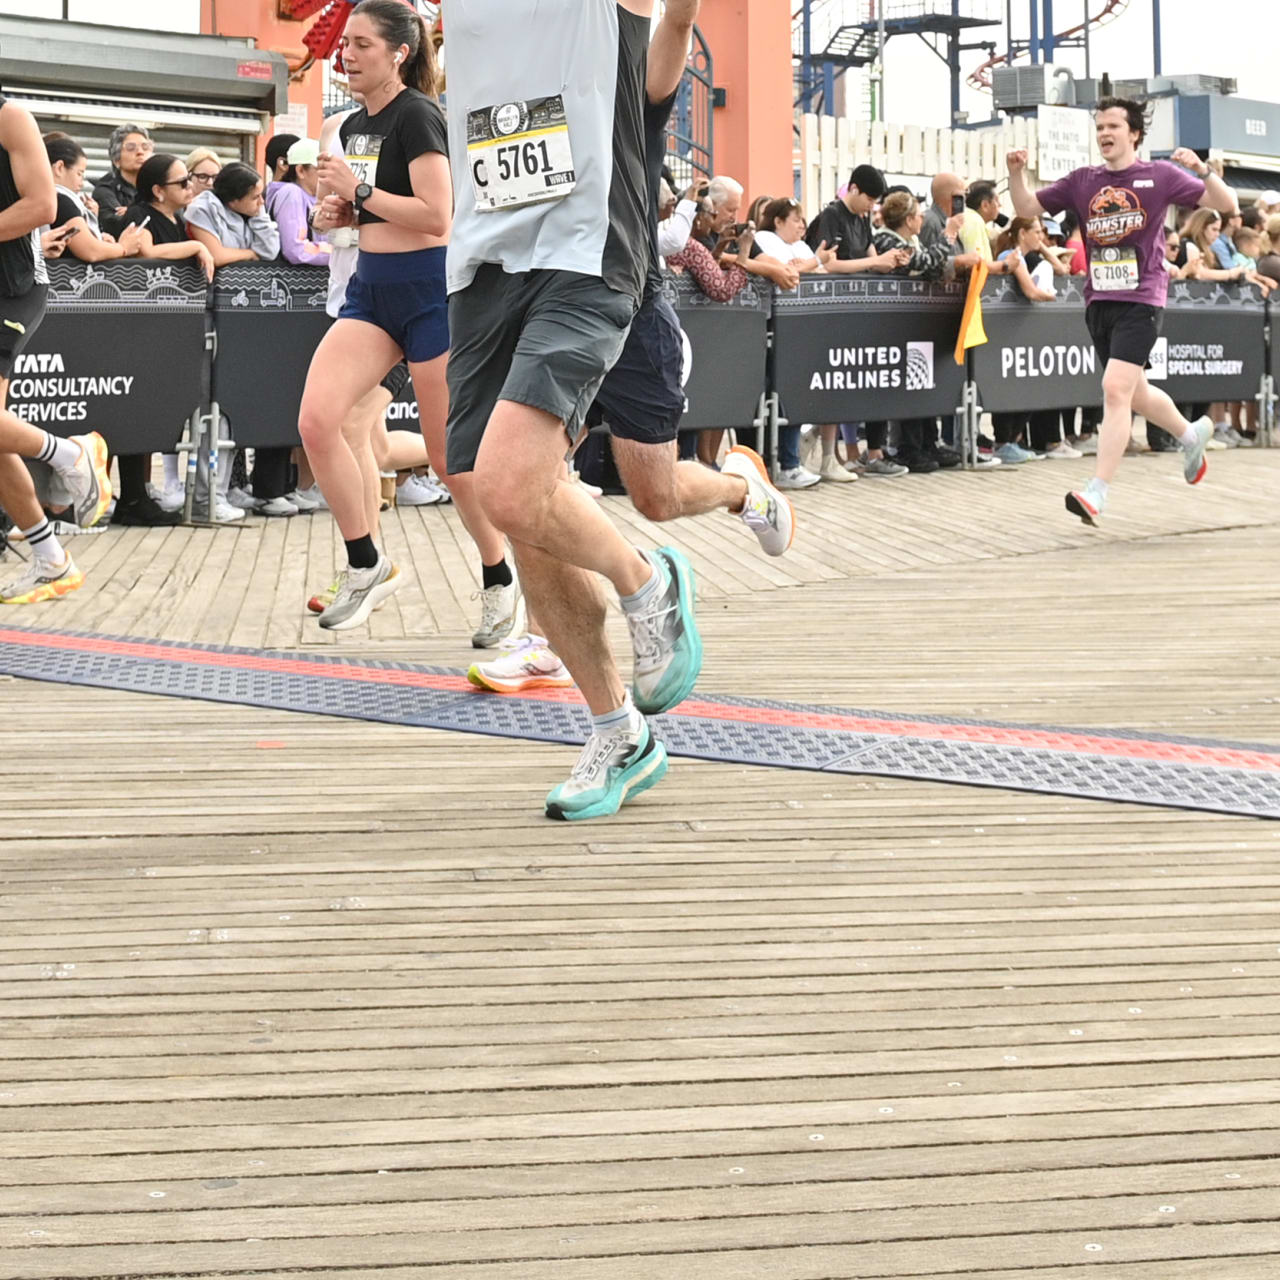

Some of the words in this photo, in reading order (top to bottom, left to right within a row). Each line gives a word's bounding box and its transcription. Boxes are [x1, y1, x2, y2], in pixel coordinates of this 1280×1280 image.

[474, 159, 488, 187] C
[497, 140, 553, 180] 5761
[1093, 268, 1100, 280] C
[1104, 265, 1129, 280] 7108
[829, 346, 901, 367] UNITED
[1001, 345, 1095, 378] PELOTON
[1168, 344, 1205, 358] HOSPITAL
[1208, 344, 1224, 357] FOR
[14, 353, 64, 373] TATA
[1168, 361, 1203, 375] SPECIAL
[1205, 360, 1243, 375] SURGERY
[9, 376, 134, 398] CONSULTANCY
[810, 369, 901, 390] AIRLINES
[8, 401, 87, 422] SERVICES
